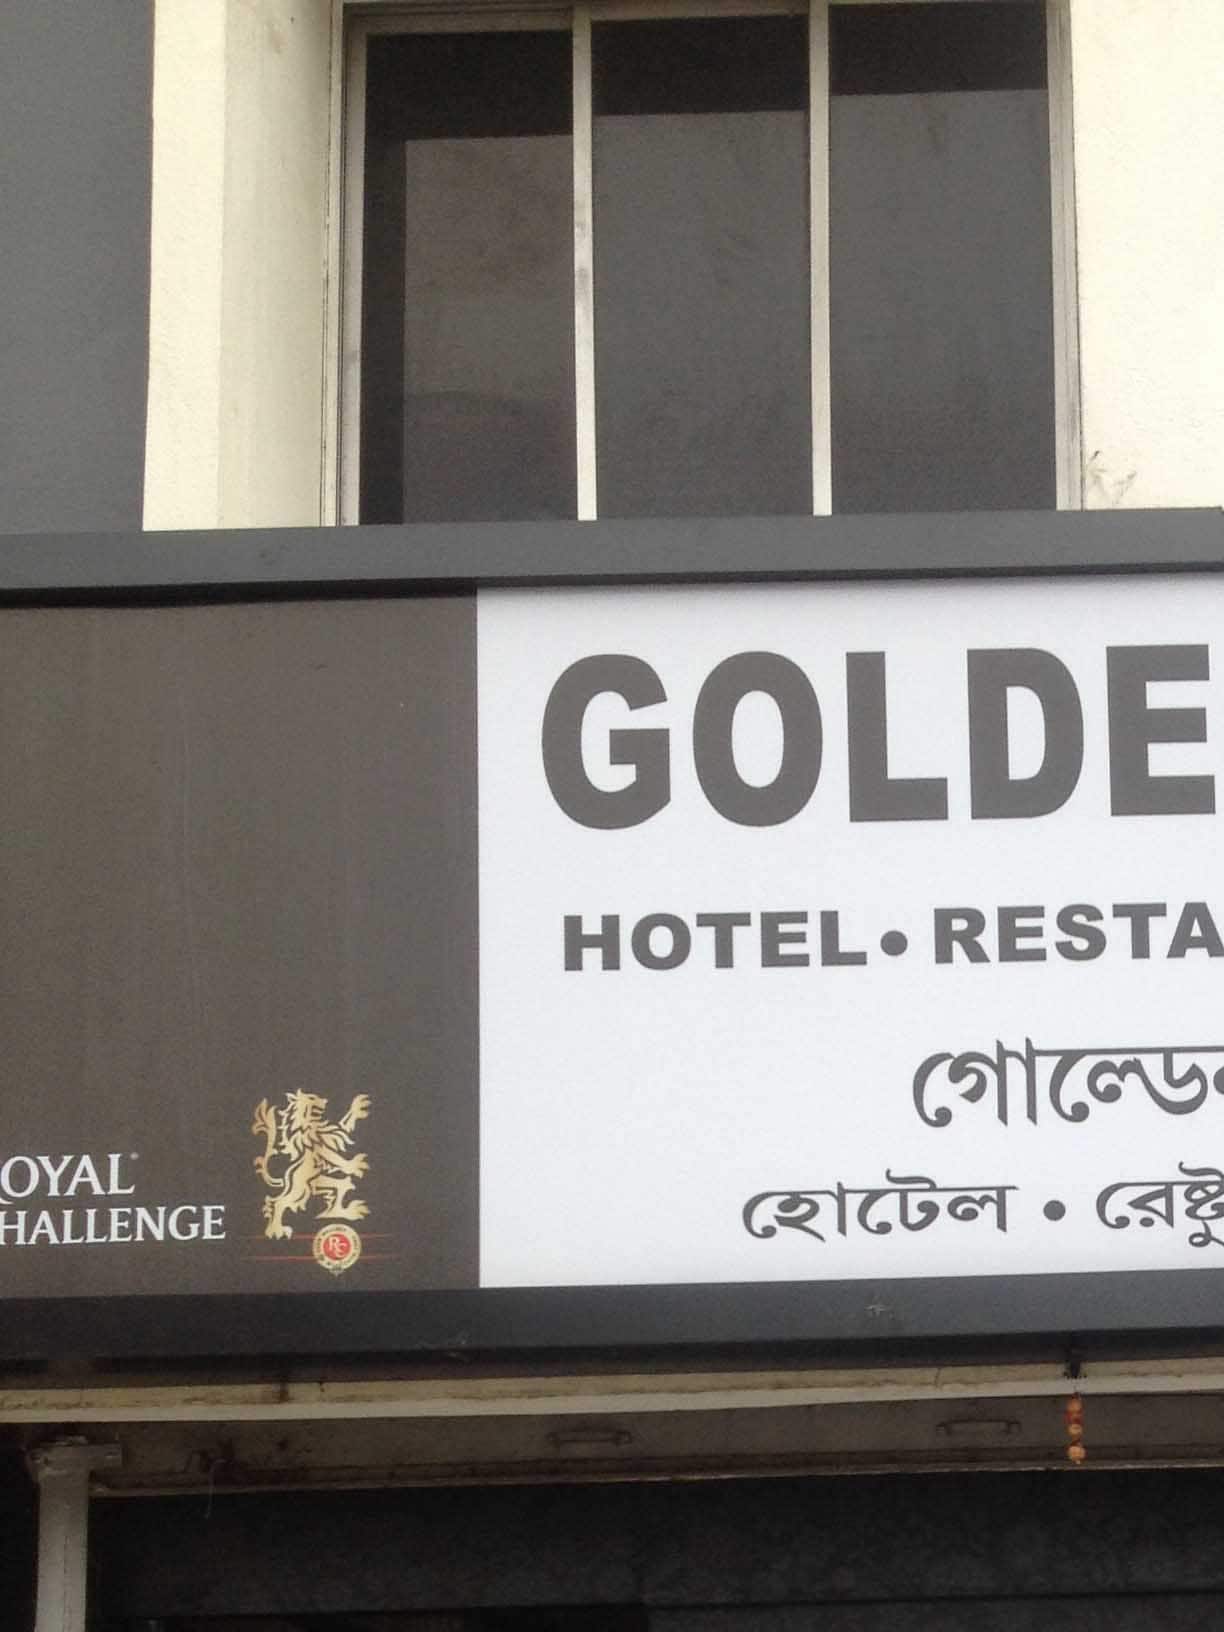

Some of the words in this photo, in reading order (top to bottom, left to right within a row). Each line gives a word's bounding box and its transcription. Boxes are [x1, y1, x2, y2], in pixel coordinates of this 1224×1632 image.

[563, 909, 868, 972] HOTEL
[0, 1153, 136, 1205] OYAL
[742, 1168, 1020, 1242] হোটেল
